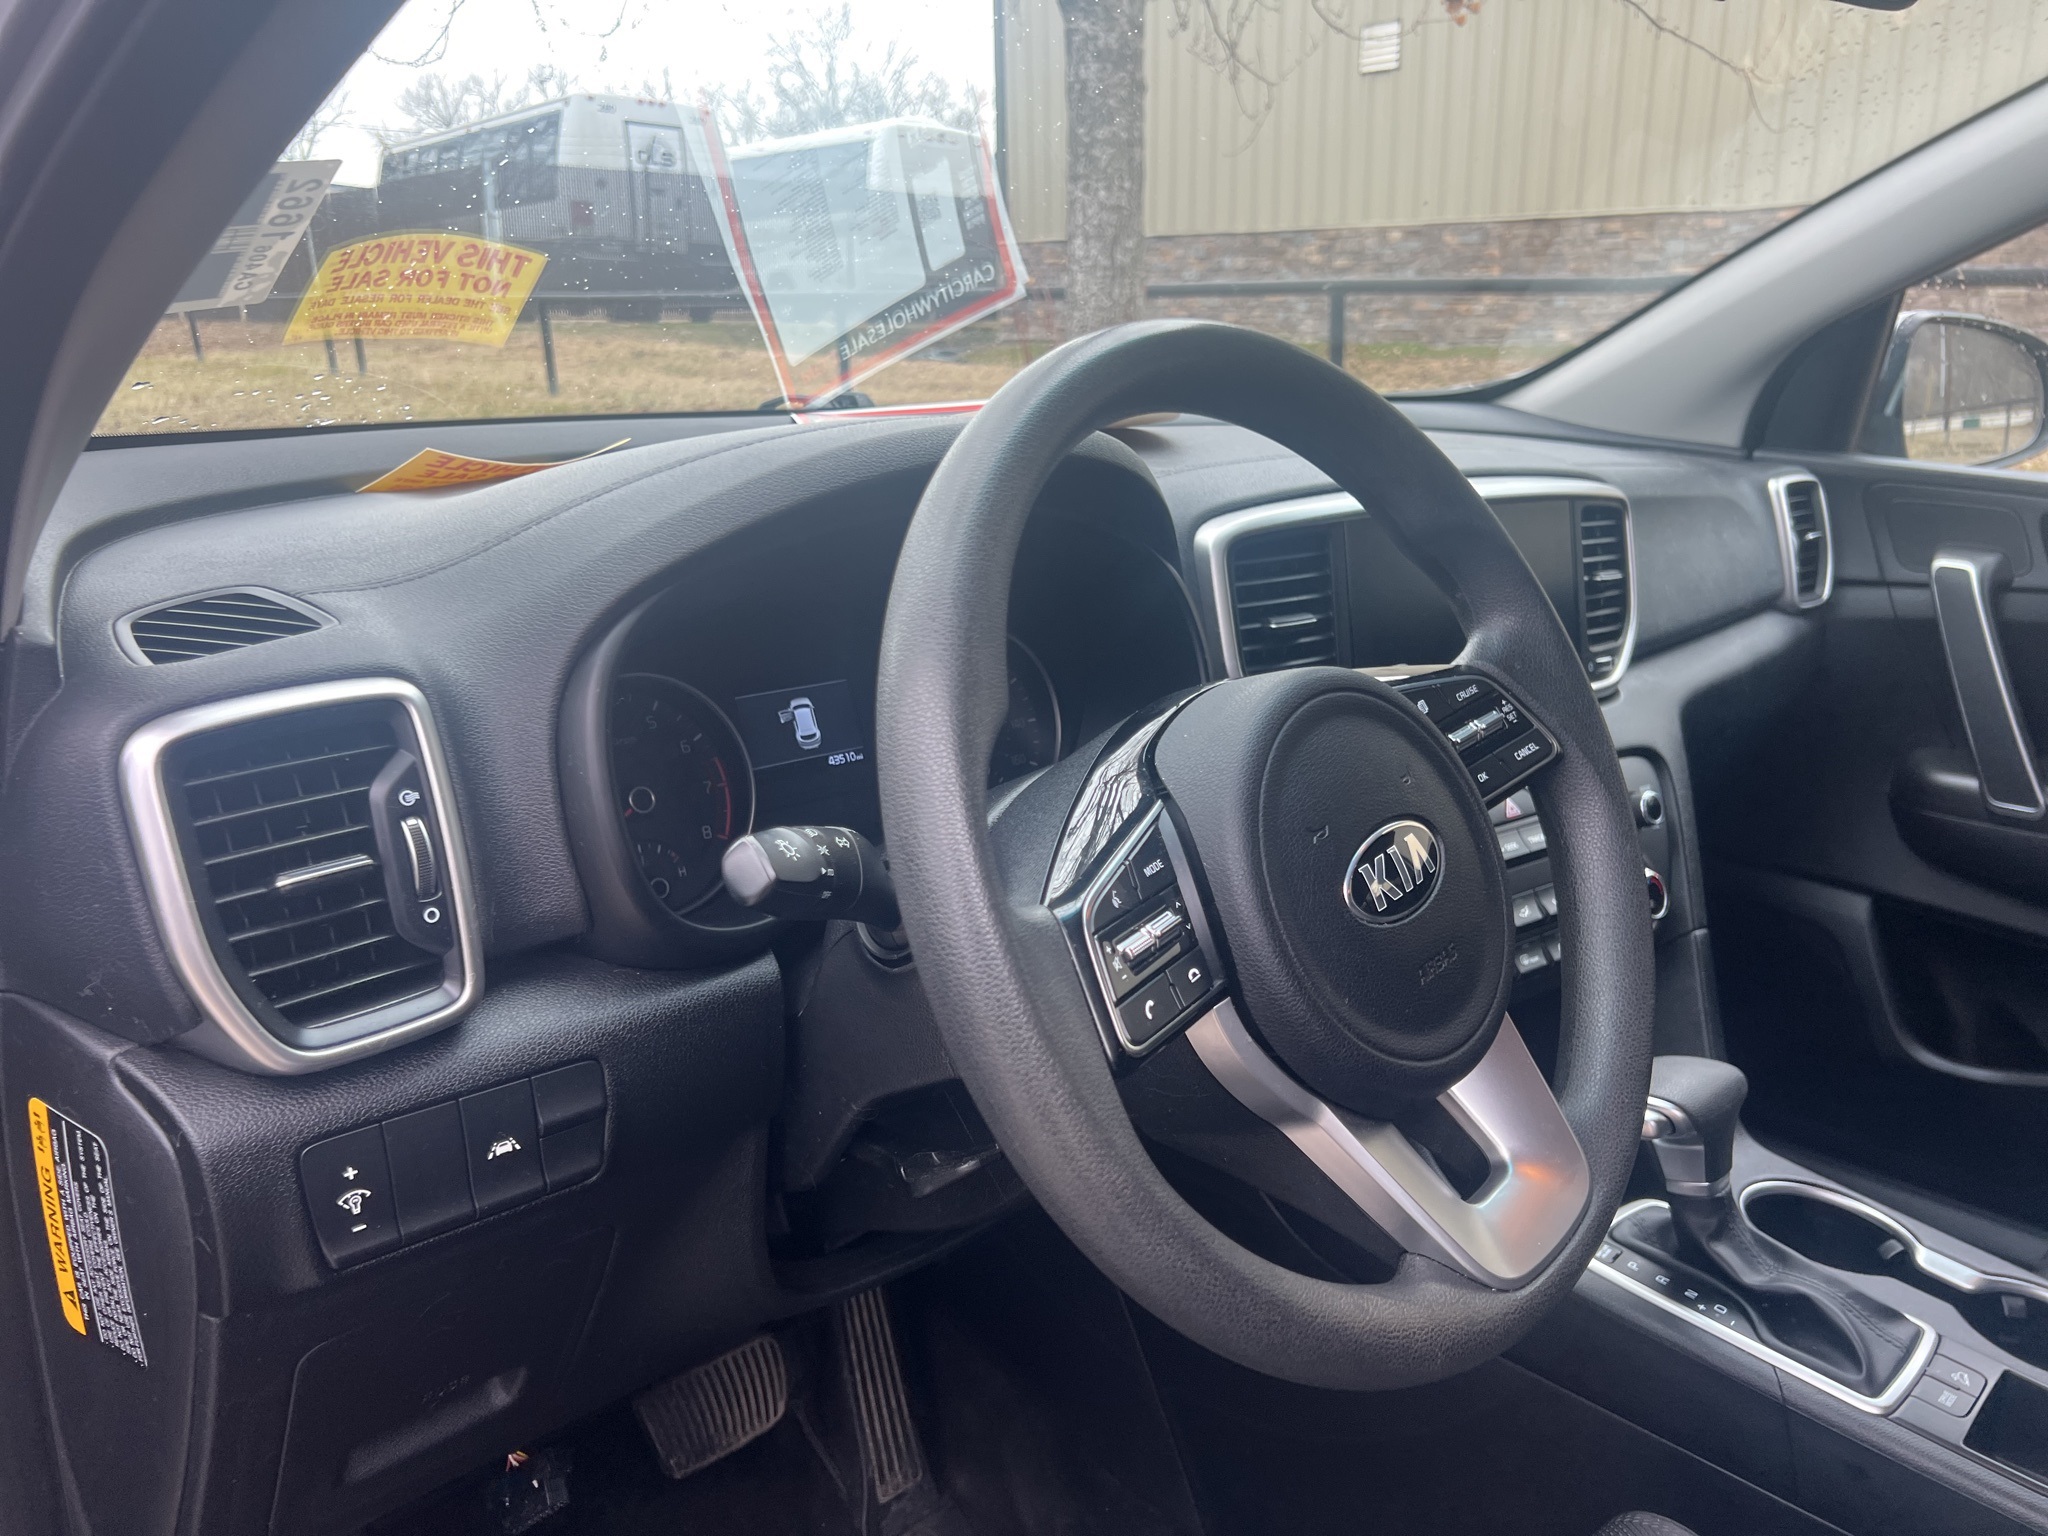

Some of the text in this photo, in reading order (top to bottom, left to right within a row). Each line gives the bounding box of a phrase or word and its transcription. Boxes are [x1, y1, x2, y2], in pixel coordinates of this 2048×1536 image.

[1456, 684, 1480, 702] CRUISE
[1506, 711, 1518, 722] SET
[1514, 742, 1540, 761] CANCEL
[1477, 771, 1490, 783] OK
[702, 825, 713, 840] 8
[1143, 858, 1165, 878] MODE
[1358, 832, 1436, 913] KIA
[41, 1166, 68, 1274] WARNING
[1627, 1261, 1639, 1272] P
[1655, 1274, 1671, 1285] R
[1684, 1288, 1699, 1300] N
[1713, 1303, 1728, 1315] D
